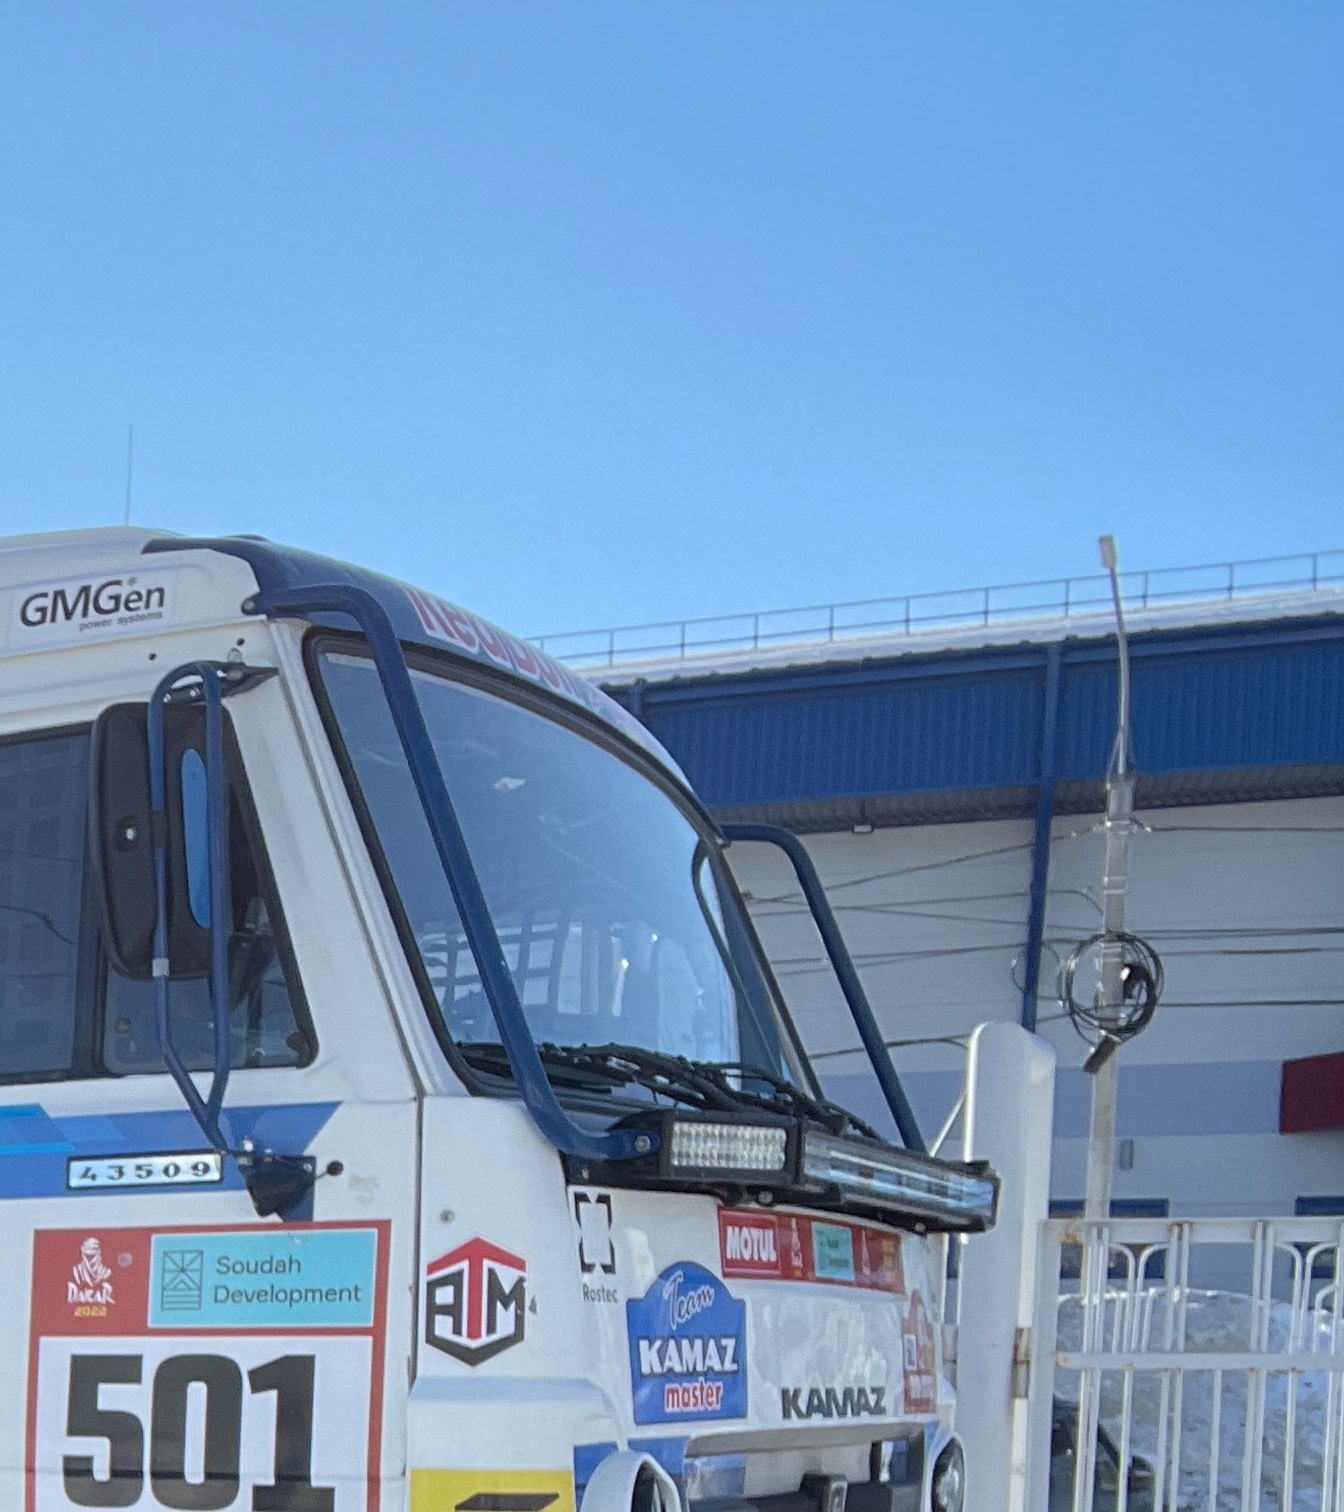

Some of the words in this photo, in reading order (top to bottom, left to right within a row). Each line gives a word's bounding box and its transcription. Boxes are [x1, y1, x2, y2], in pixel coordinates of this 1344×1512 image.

[20, 579, 166, 627] GMGen
[79, 1160, 211, 1182] 43509
[725, 1226, 778, 1262] MOTUL
[215, 1254, 302, 1277] Soudah
[213, 1283, 362, 1307] Development
[582, 1283, 618, 1304] Rostec
[663, 1270, 715, 1331] Team
[638, 1337, 738, 1376] KAMAZ
[665, 1377, 724, 1414] master
[782, 1387, 887, 1419] KAMAZ
